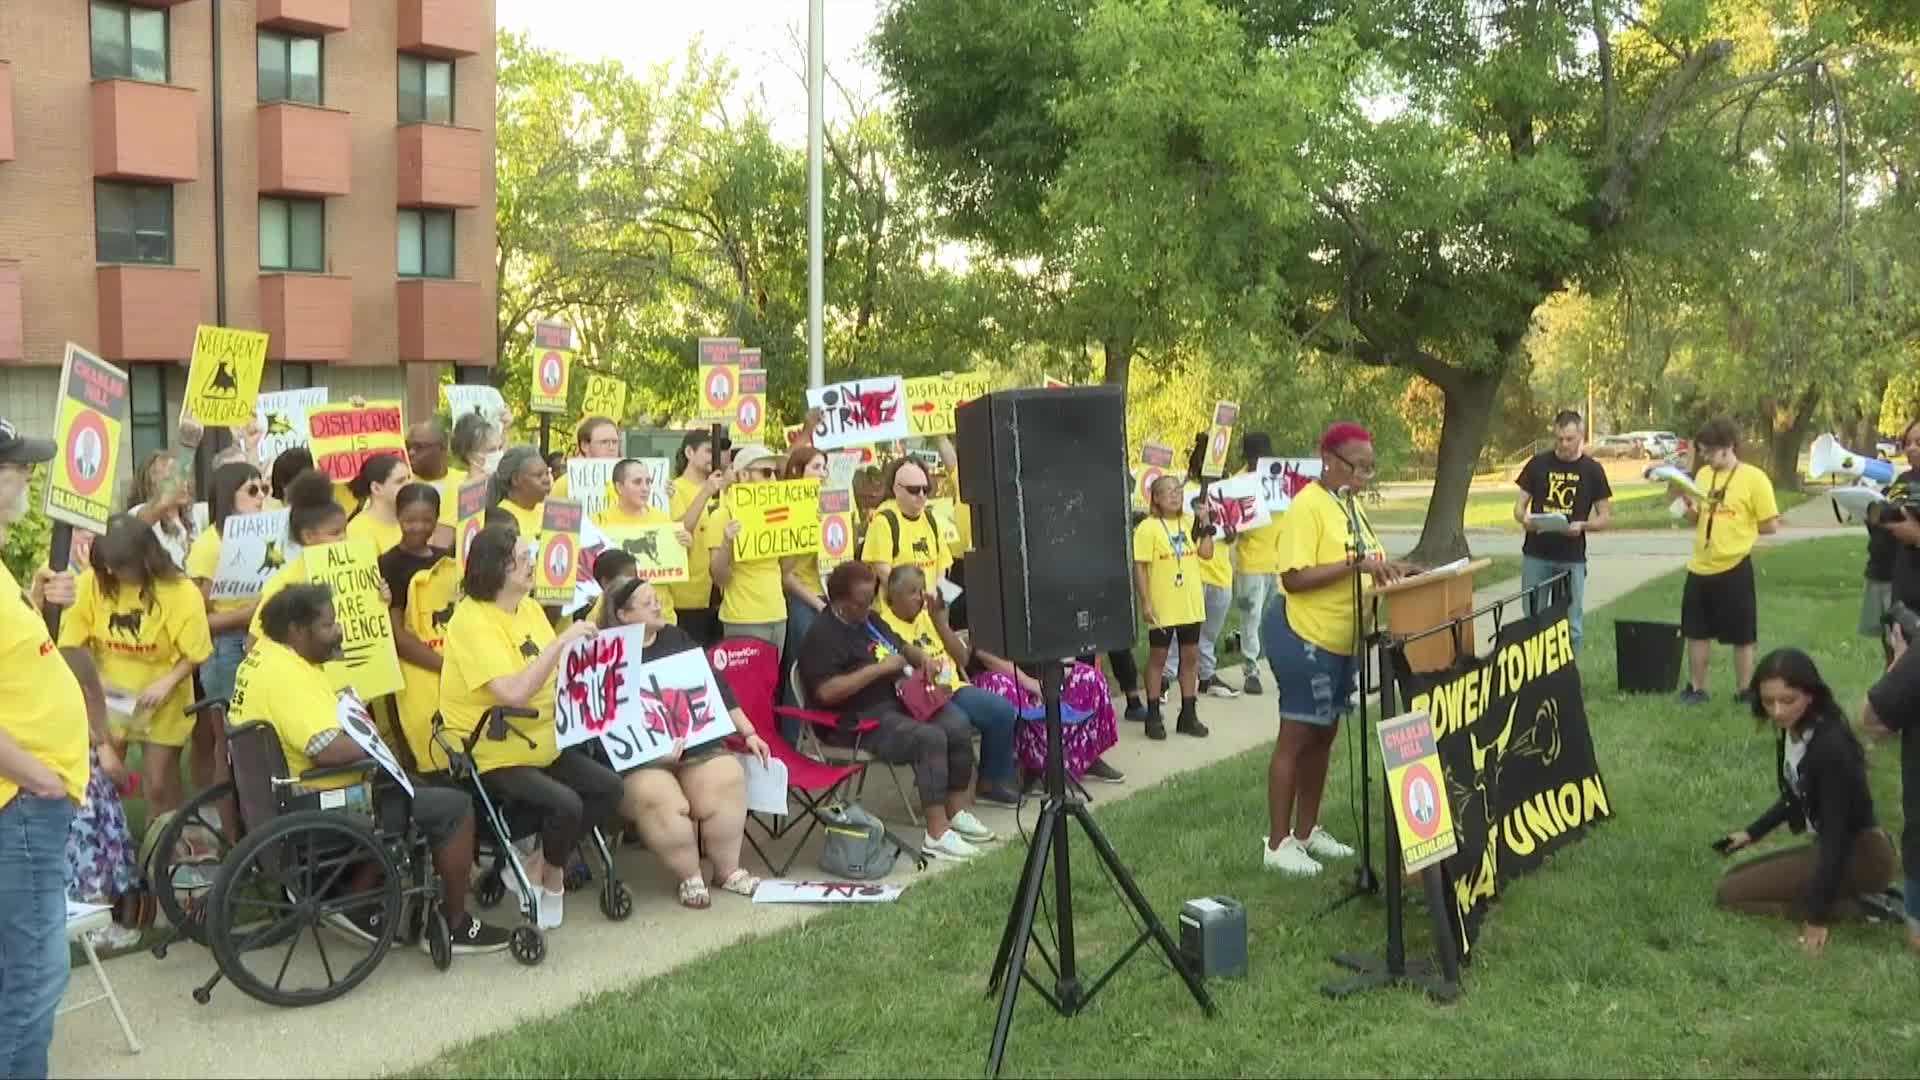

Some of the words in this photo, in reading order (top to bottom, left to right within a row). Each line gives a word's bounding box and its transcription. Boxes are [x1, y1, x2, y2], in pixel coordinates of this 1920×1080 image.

[592, 378, 618, 398] OUR
[822, 383, 861, 406] ON
[584, 397, 618, 416] CITY
[912, 413, 953, 432] VIOL
[1546, 480, 1577, 508] KC
[735, 525, 819, 559] VIOLENCE
[328, 545, 355, 567] ALL
[337, 596, 366, 619] ARE
[343, 615, 390, 643] LENCE
[1496, 618, 1574, 697] TOWER
[1503, 773, 1610, 856] UNION
